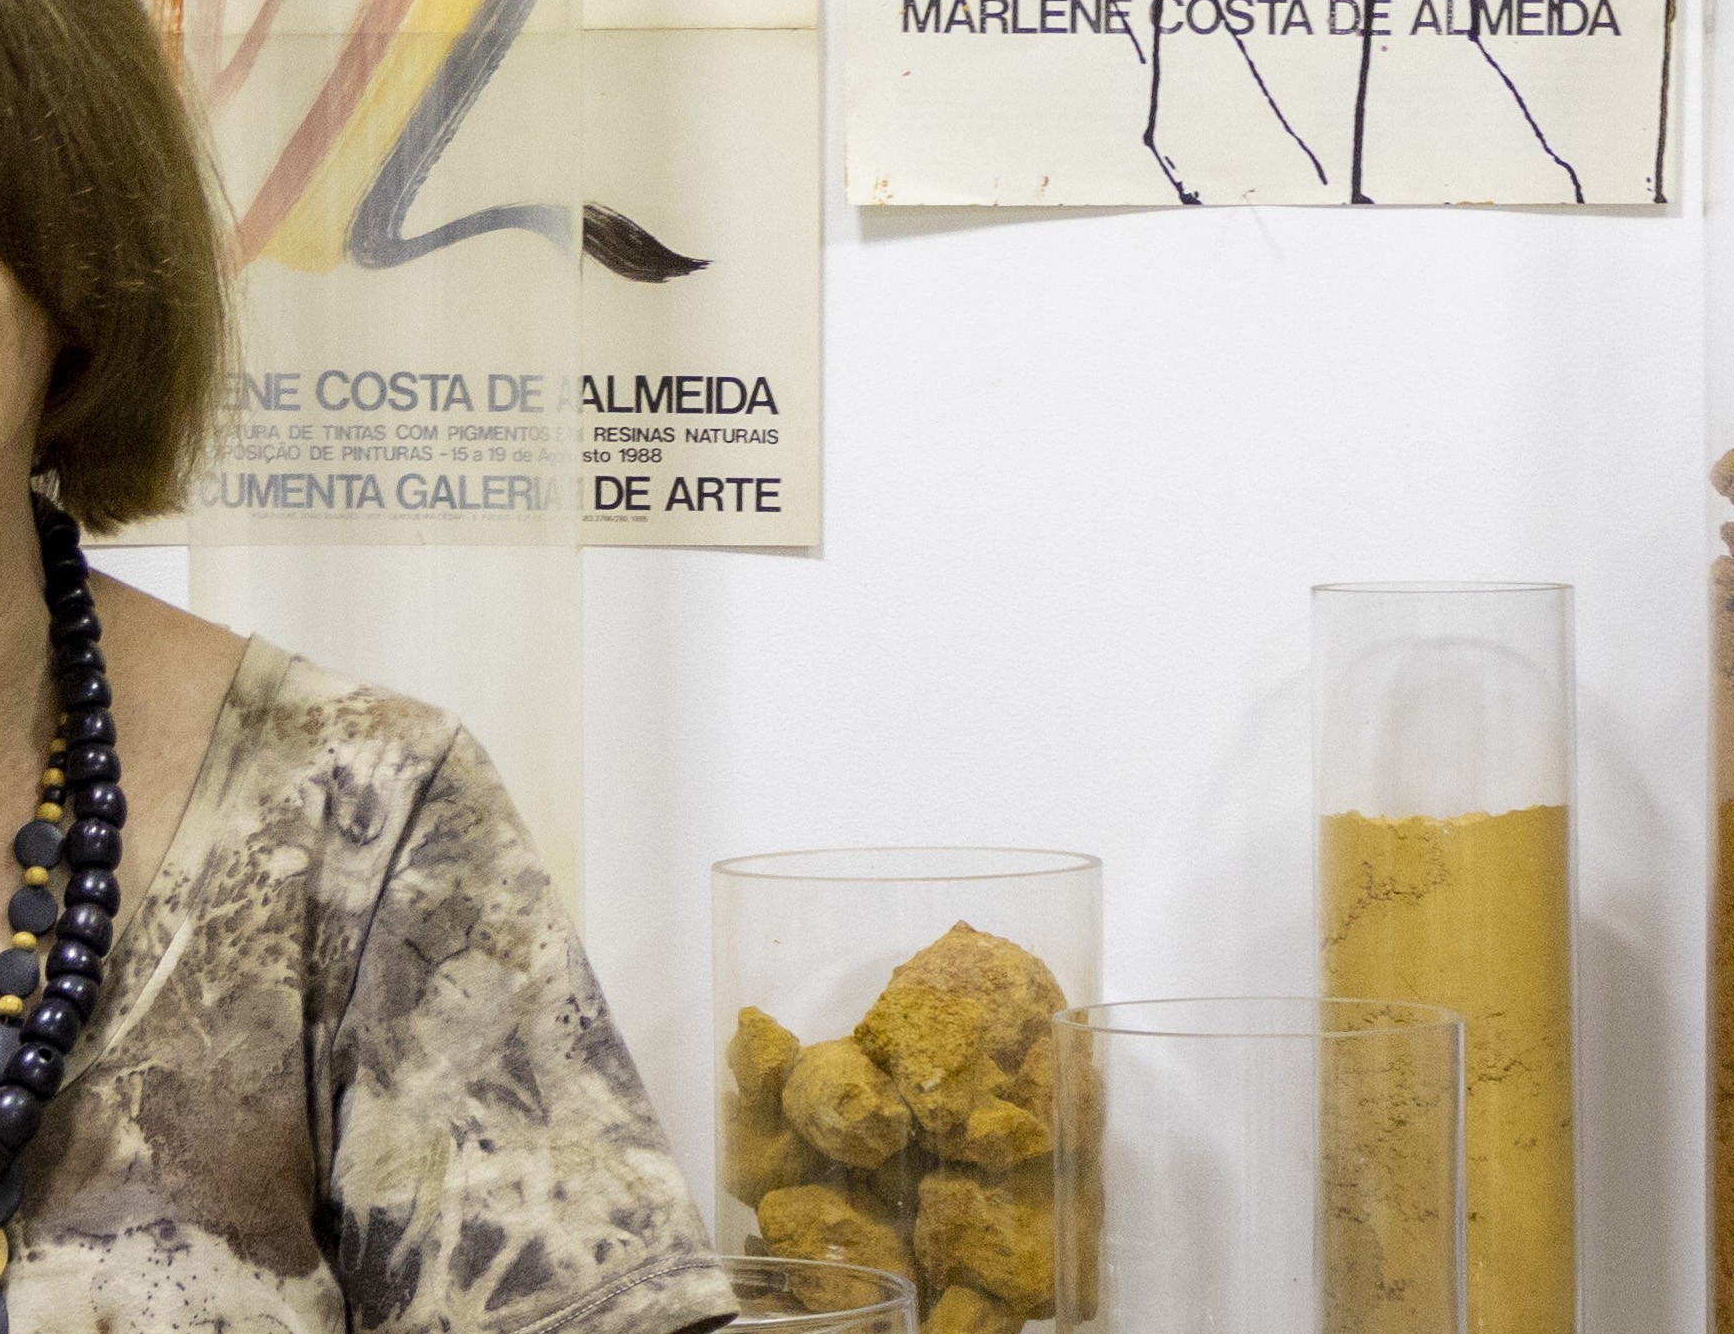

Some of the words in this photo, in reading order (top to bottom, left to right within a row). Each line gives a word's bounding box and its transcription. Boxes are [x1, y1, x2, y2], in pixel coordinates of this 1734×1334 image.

[223, 372, 301, 411] ENE
[316, 370, 474, 411] COSTA
[487, 373, 544, 413] DE
[581, 375, 779, 415] ALMEIDA
[288, 425, 314, 441] DE
[323, 425, 387, 441] TINTAS
[395, 425, 439, 441] COM
[447, 425, 549, 442] PIGMENTOS
[593, 427, 675, 444] RESINAS
[684, 428, 779, 445] NATURAIS
[309, 446, 334, 461] DE
[341, 445, 433, 462] PINTURAS
[472, 450, 483, 462] a
[488, 447, 507, 463] 19
[512, 447, 533, 463] de
[619, 447, 663, 464] 1988
[396, 473, 561, 511] GALERIA
[594, 475, 651, 511] DE
[665, 476, 782, 513] ARTE
